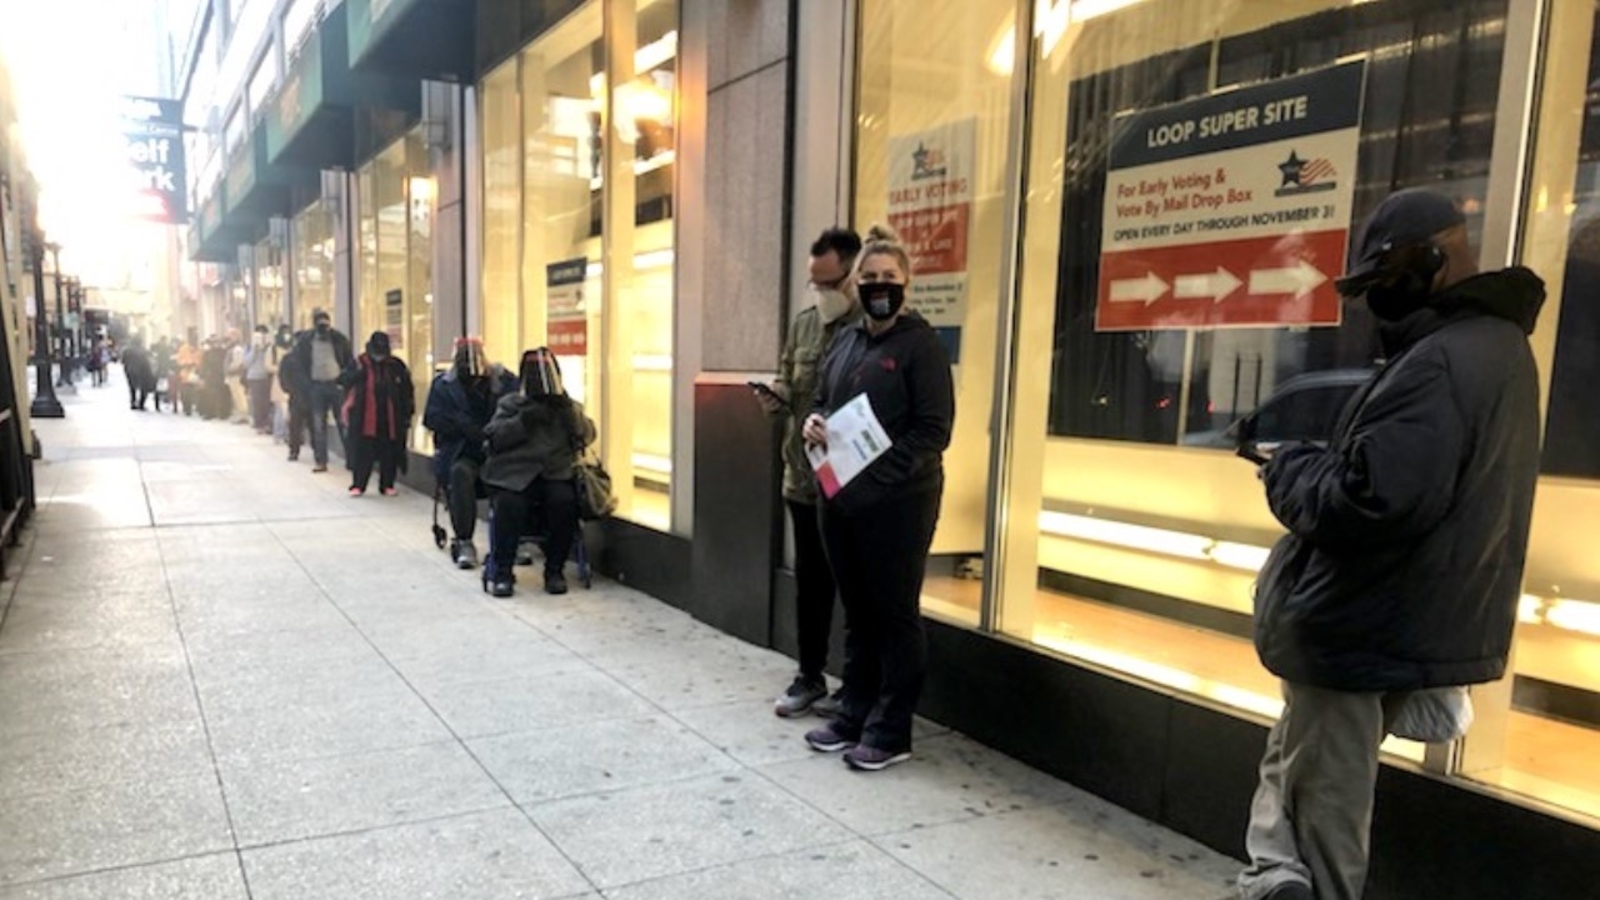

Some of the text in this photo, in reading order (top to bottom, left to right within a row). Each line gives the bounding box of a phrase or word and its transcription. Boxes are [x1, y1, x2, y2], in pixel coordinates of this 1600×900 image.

[1147, 96, 1308, 148] LOOP SUPER SITE
[1118, 168, 1226, 198] For Early Voting &
[1116, 188, 1252, 218] Vote By Mail Drop Box
[1114, 228, 1139, 241] OPEN
[1141, 224, 1171, 239] EVERY
[1172, 221, 1195, 235] DAY
[1197, 213, 1249, 231] THROUGH
[1250, 206, 1320, 226] NOVEMBER
